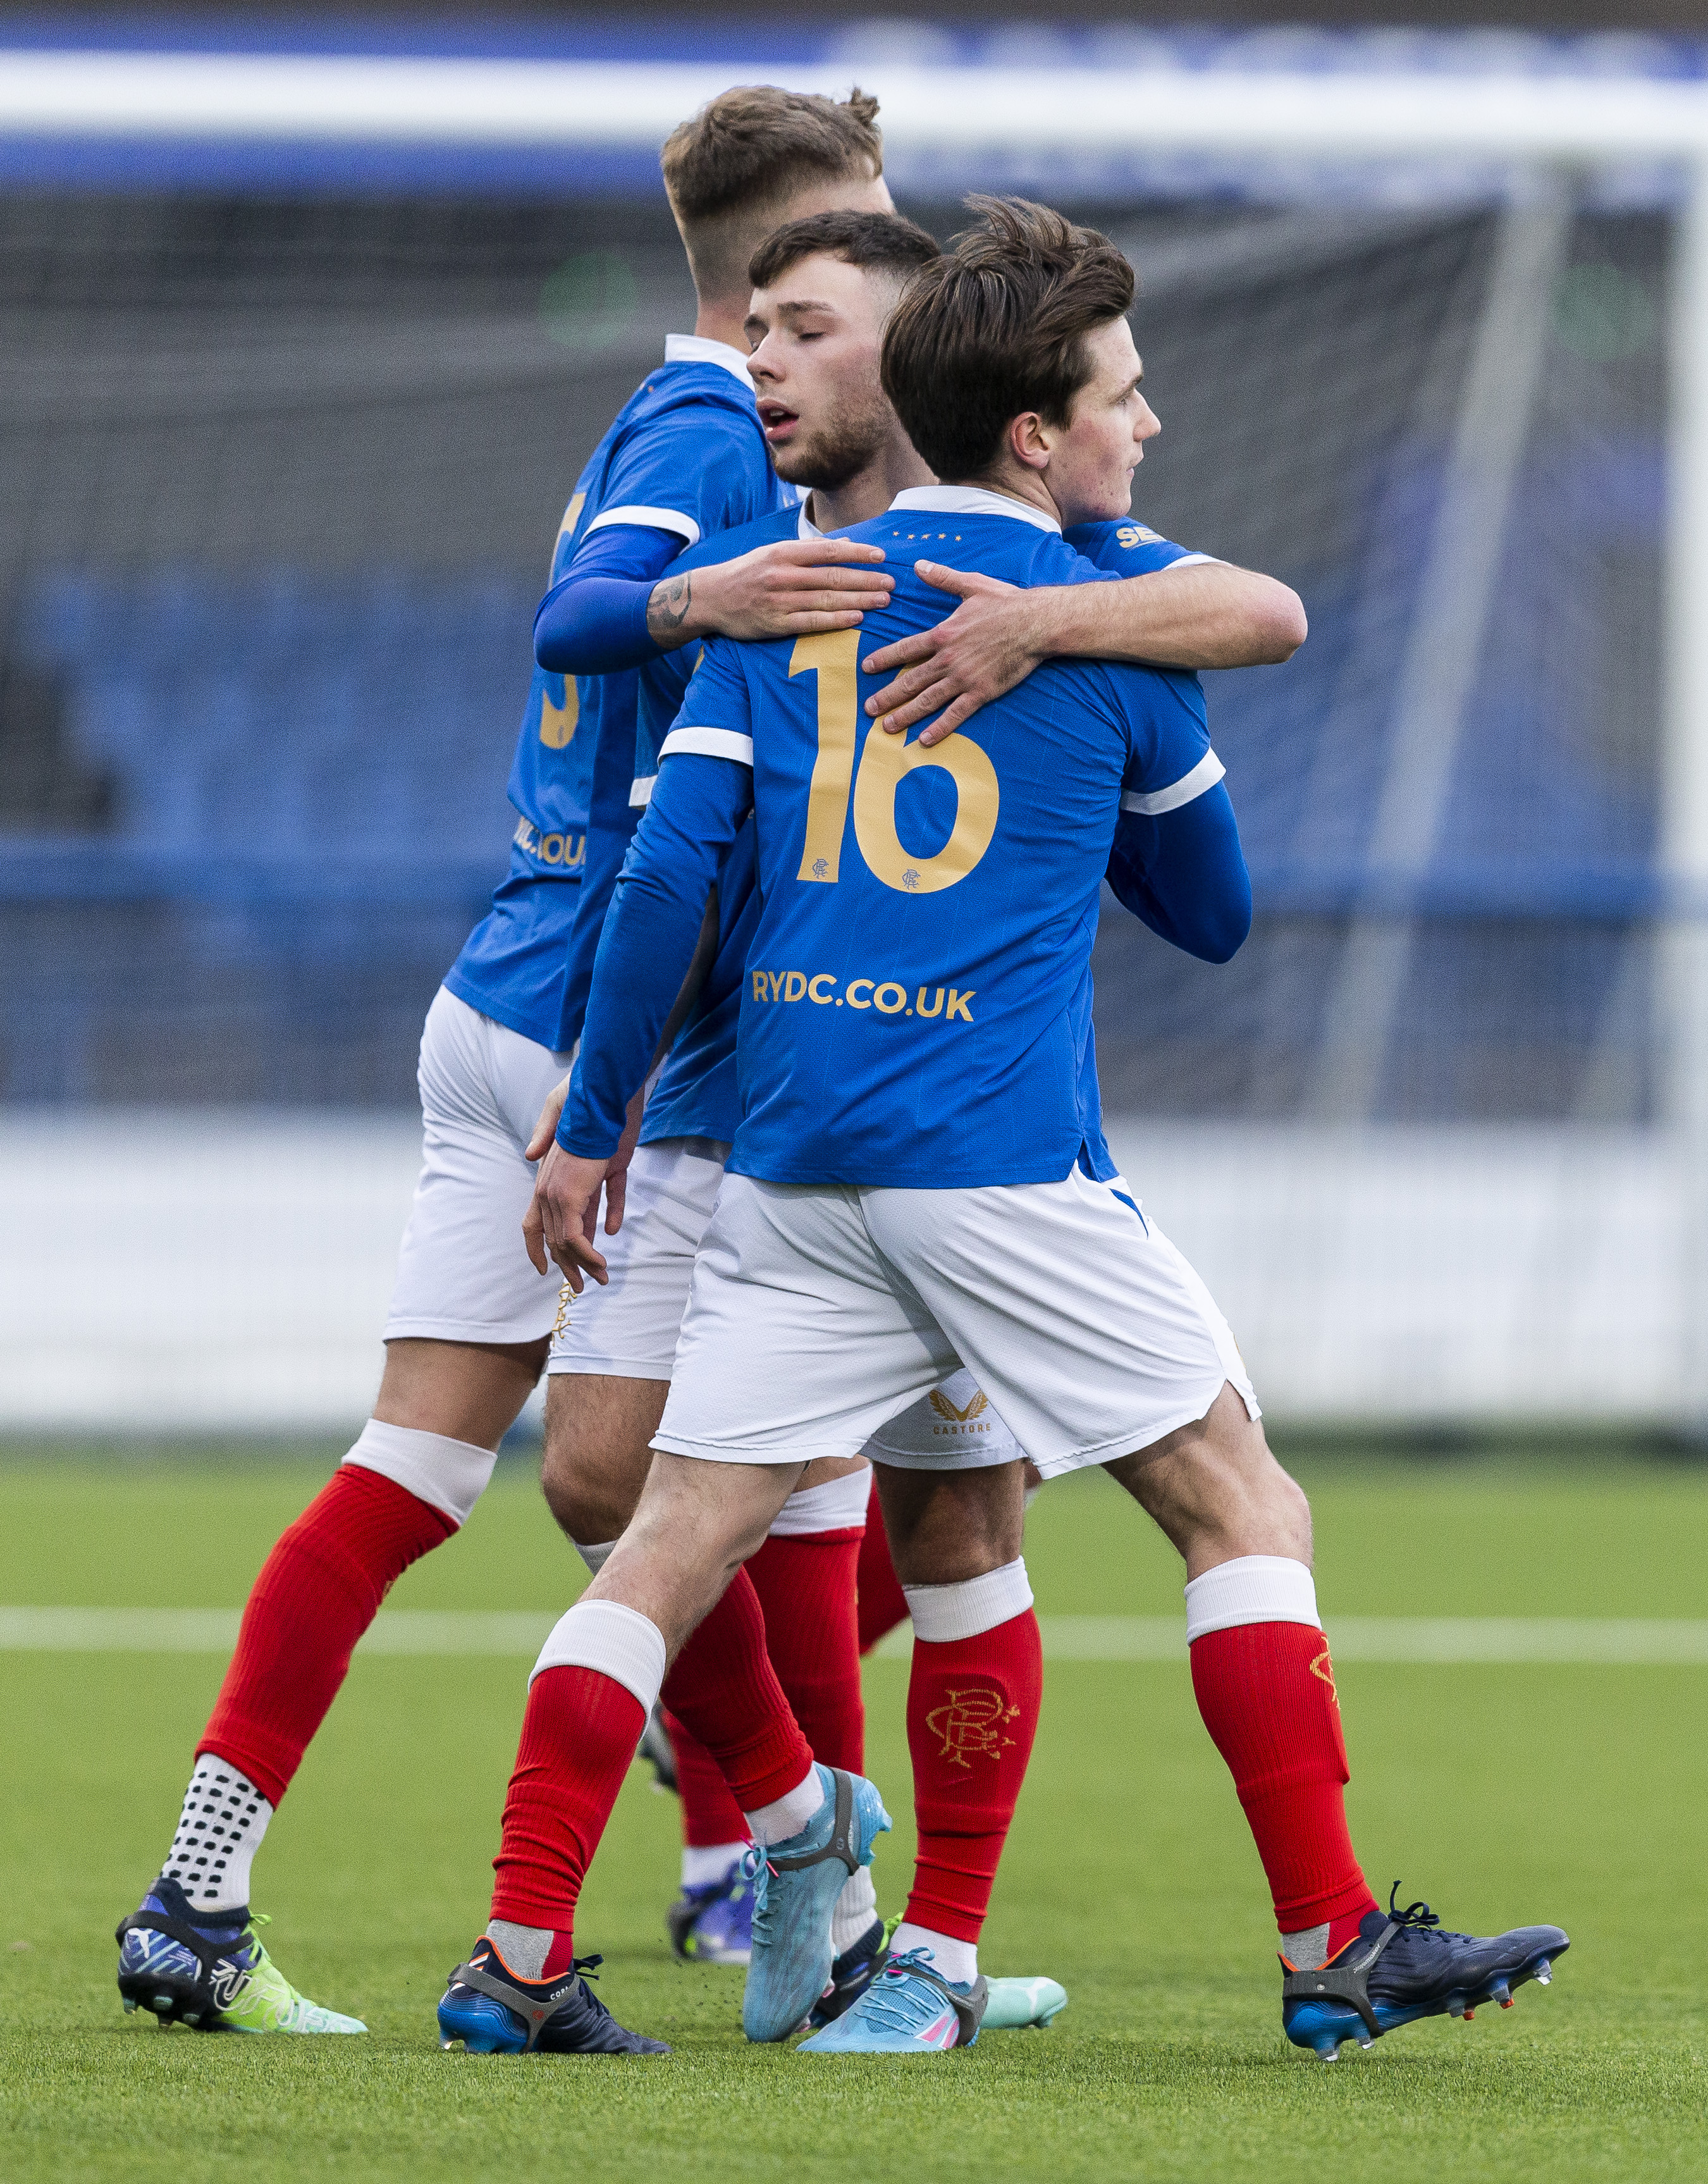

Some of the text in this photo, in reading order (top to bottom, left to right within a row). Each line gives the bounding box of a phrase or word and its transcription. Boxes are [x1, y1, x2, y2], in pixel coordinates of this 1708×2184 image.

[788, 629, 1000, 894] 16
[752, 970, 976, 1022] RYDC.CO.UK
[933, 1423, 992, 1435] CASTORE
